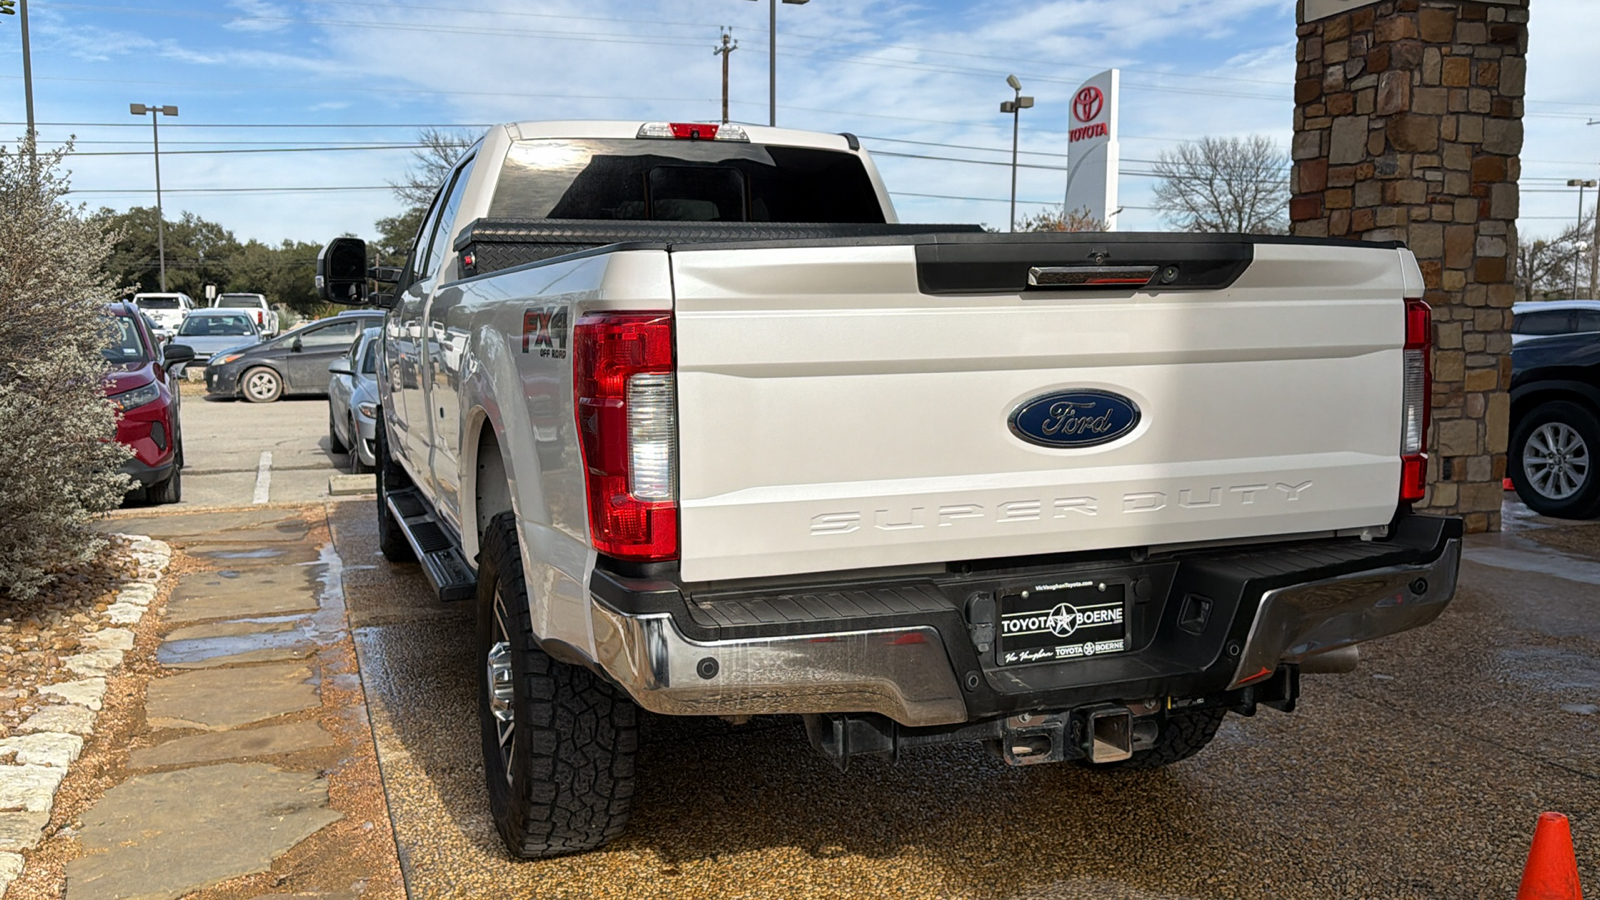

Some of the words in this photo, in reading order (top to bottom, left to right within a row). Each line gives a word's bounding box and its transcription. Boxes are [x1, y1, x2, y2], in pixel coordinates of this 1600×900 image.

[1069, 122, 1107, 143] TOYOTA
[522, 306, 568, 353] FX4
[540, 348, 550, 358] OFF
[551, 349, 567, 359] ROAD
[1042, 401, 1113, 435] Ford
[810, 496, 1098, 536] SUPER
[1122, 479, 1313, 514] DUTY
[1002, 615, 1055, 632] TOYOTA
[1076, 608, 1123, 625] BOERNE
[1056, 646, 1083, 656] TOYOTA
[1095, 641, 1124, 651] BOERNE
